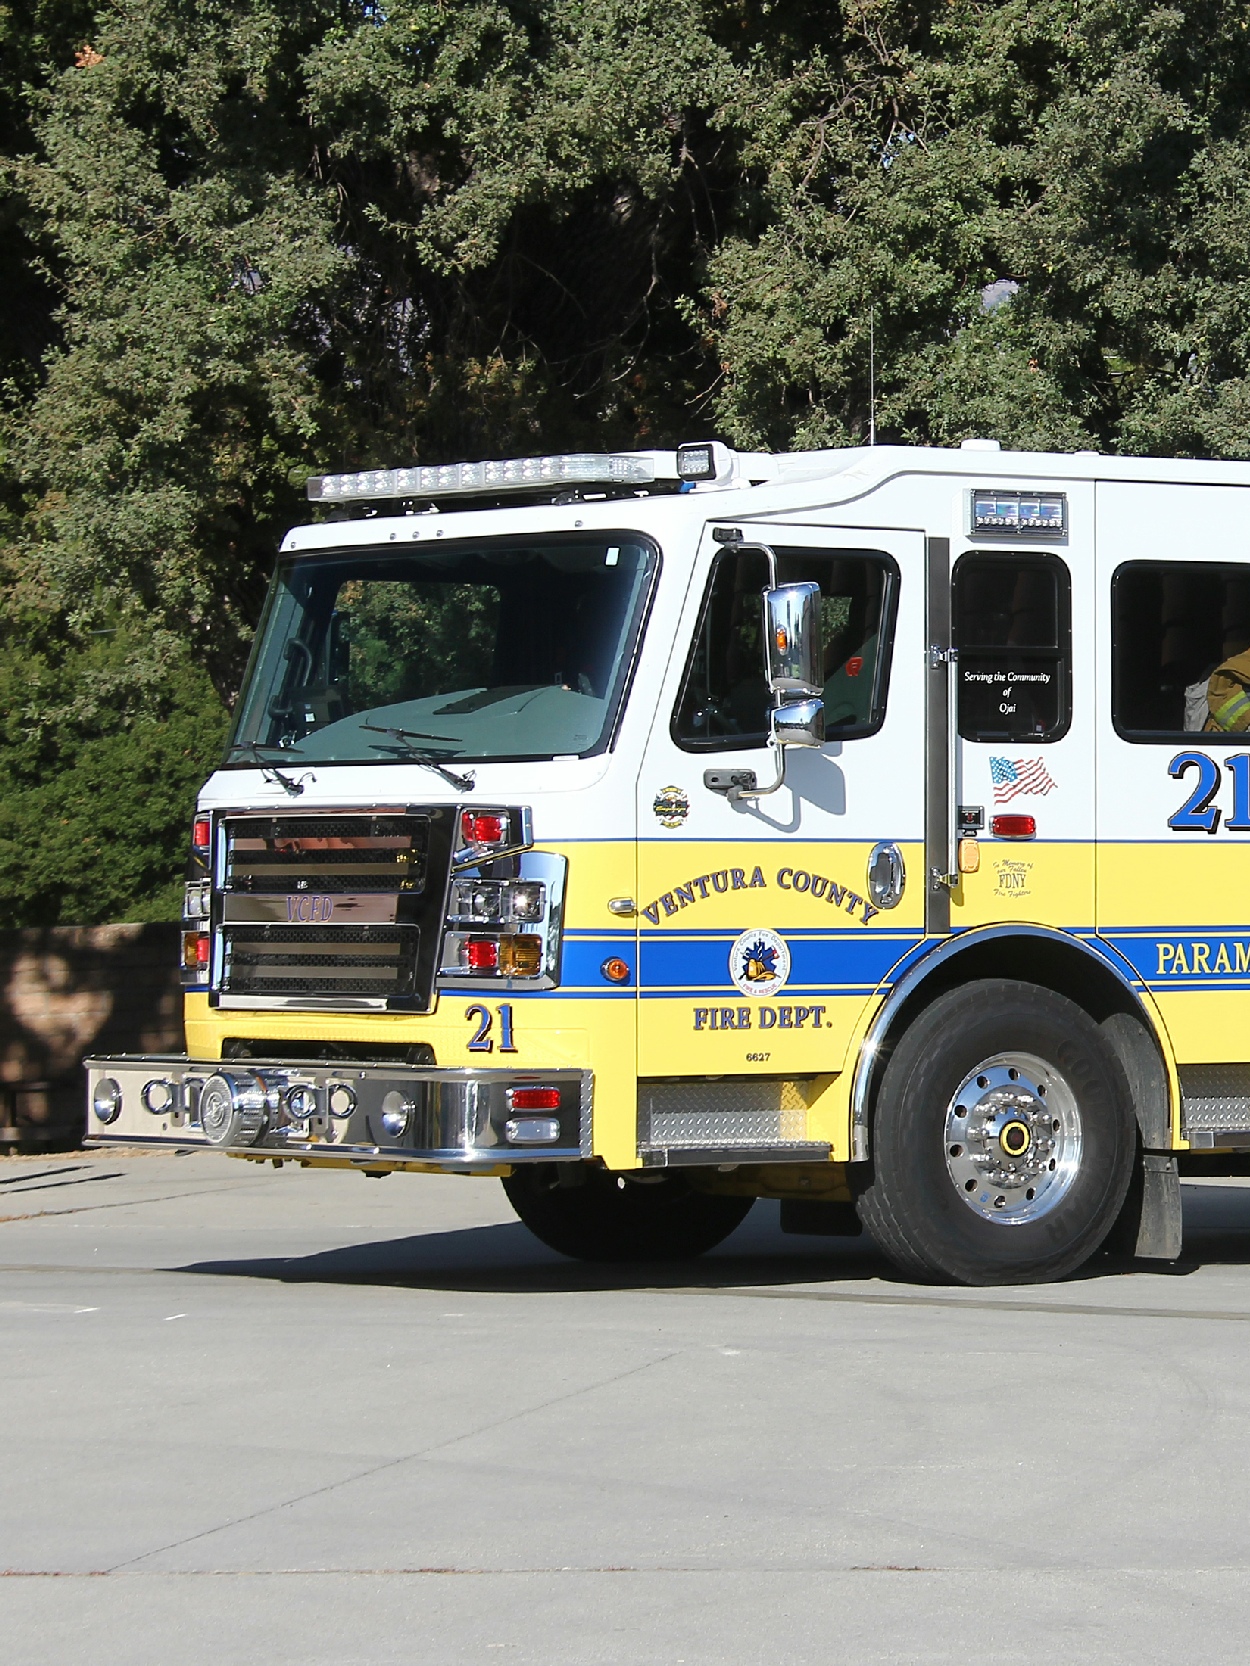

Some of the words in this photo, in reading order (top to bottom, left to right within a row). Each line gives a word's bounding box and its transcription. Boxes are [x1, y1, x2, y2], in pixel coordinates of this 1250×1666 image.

[964, 671, 993, 684] Serving
[994, 671, 1006, 681] the
[1007, 671, 1051, 684] Community
[1002, 686, 1013, 698] of
[999, 702, 1017, 715] Ojai
[999, 873, 1026, 888] FDNY
[641, 866, 767, 925] VENTURA
[777, 867, 879, 926] COUNTY
[286, 896, 333, 922] VCFD
[693, 1007, 752, 1031] FIRE
[758, 1005, 833, 1029] DEPT.
[465, 1003, 518, 1054] 21
[745, 1052, 772, 1063] 6627
